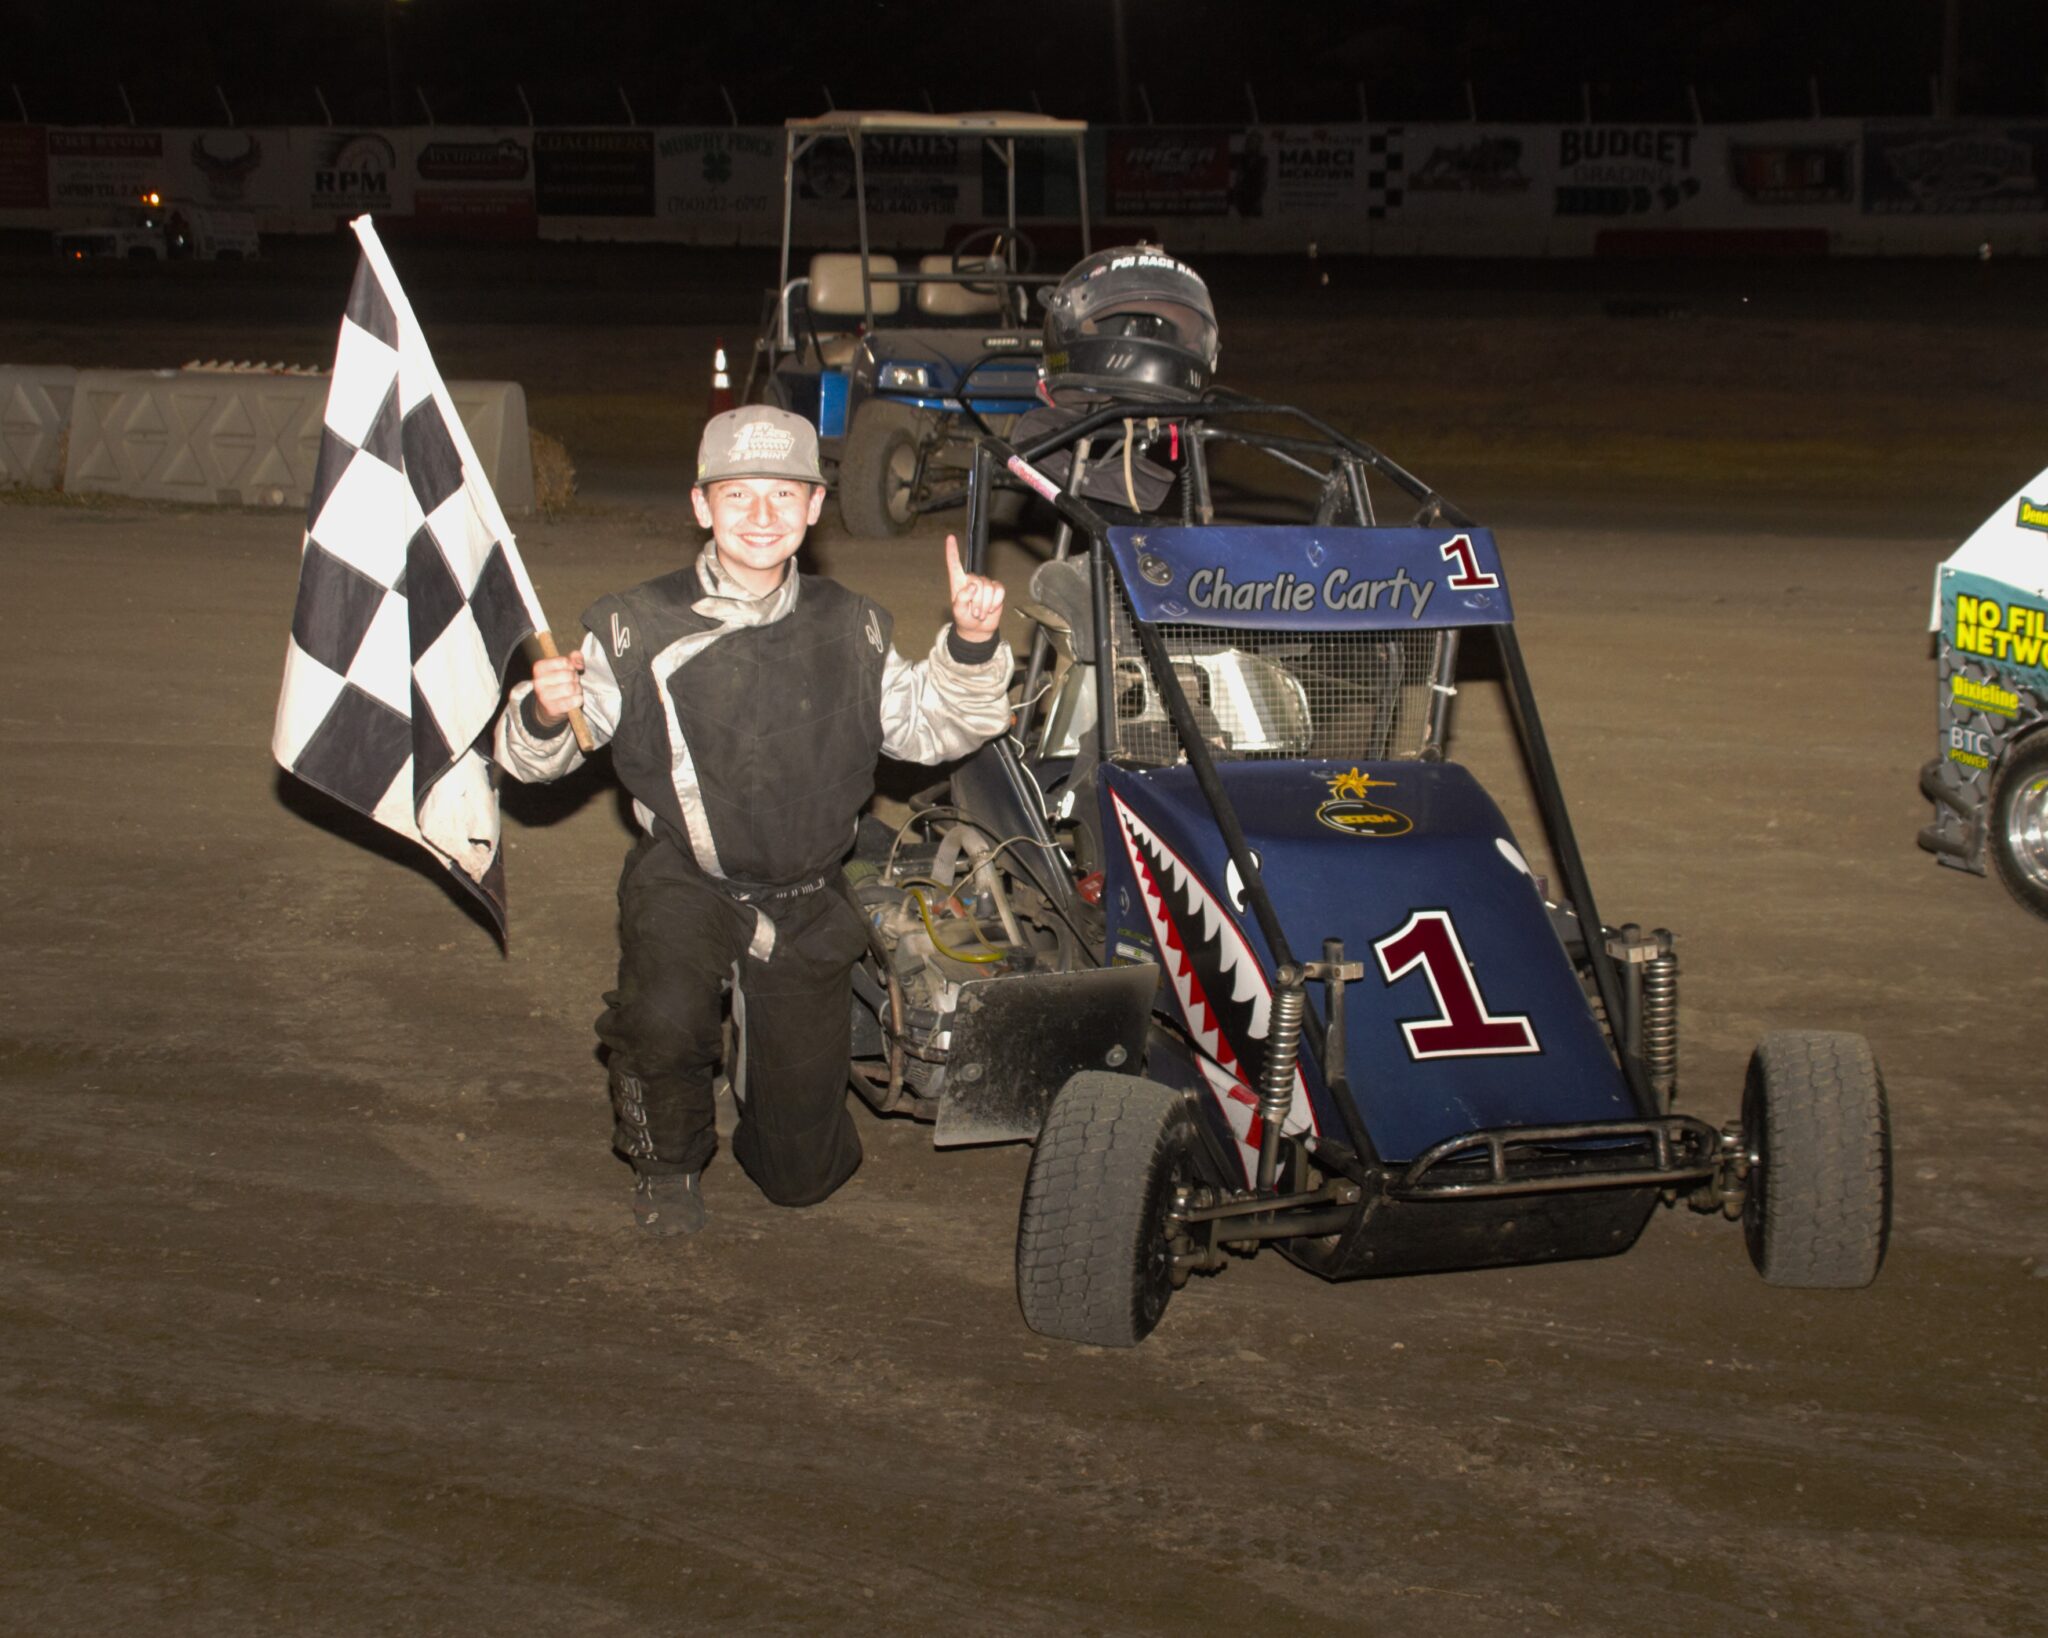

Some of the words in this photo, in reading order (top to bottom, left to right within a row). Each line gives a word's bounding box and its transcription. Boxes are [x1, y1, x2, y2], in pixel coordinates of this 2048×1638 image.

[1279, 149, 1355, 165] MARCI
[1559, 129, 1698, 168] BUDGET
[315, 171, 388, 192] RPM
[1574, 166, 1673, 184] GRADING
[1138, 255, 1175, 268] RACE
[1439, 534, 1499, 590] 1
[1188, 567, 1315, 612] Charlie
[1322, 567, 1435, 620] Carty
[1956, 594, 2001, 630] NO
[1952, 675, 2019, 710] Dixieline
[1951, 726, 1989, 756] BTC
[1950, 748, 1989, 769] POWER
[1370, 907, 1545, 1062] 1
